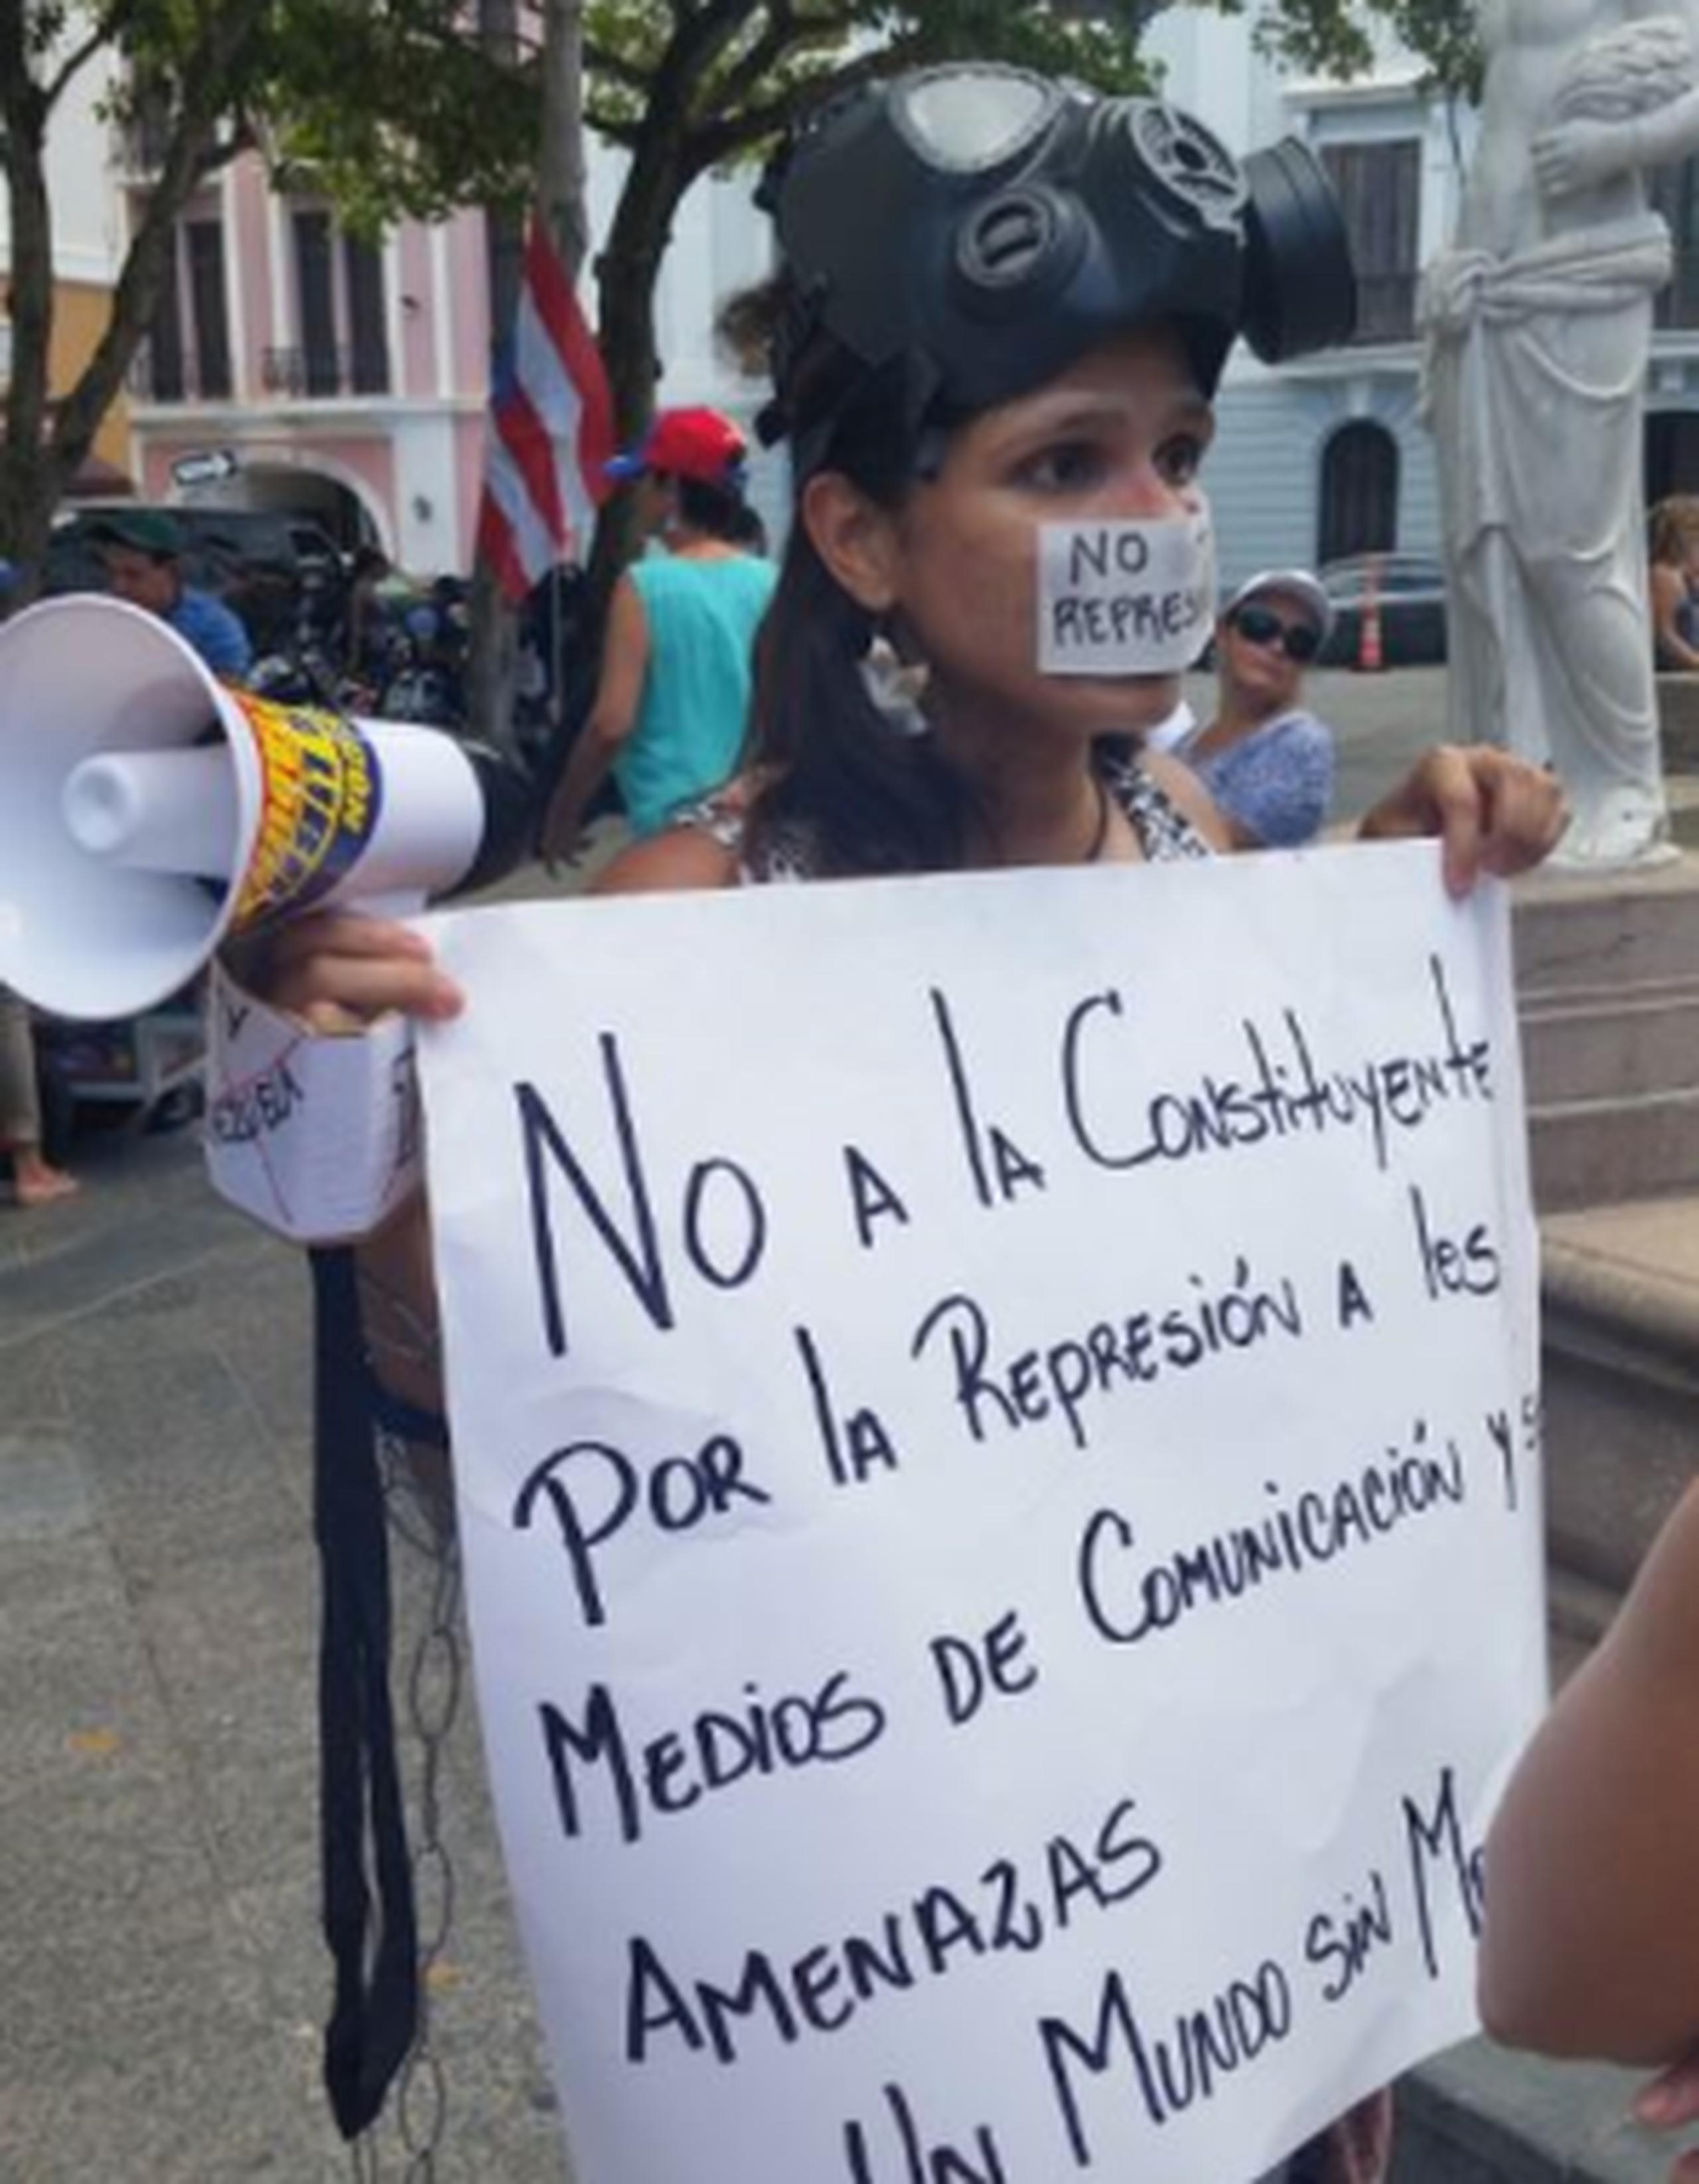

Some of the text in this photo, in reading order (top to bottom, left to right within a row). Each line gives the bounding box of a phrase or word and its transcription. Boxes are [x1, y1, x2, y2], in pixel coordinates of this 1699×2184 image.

[1070, 529, 1149, 586] NO
[842, 1143, 910, 1249] A
[1338, 1261, 1374, 1329] A
[928, 1609, 1039, 1727] DE
